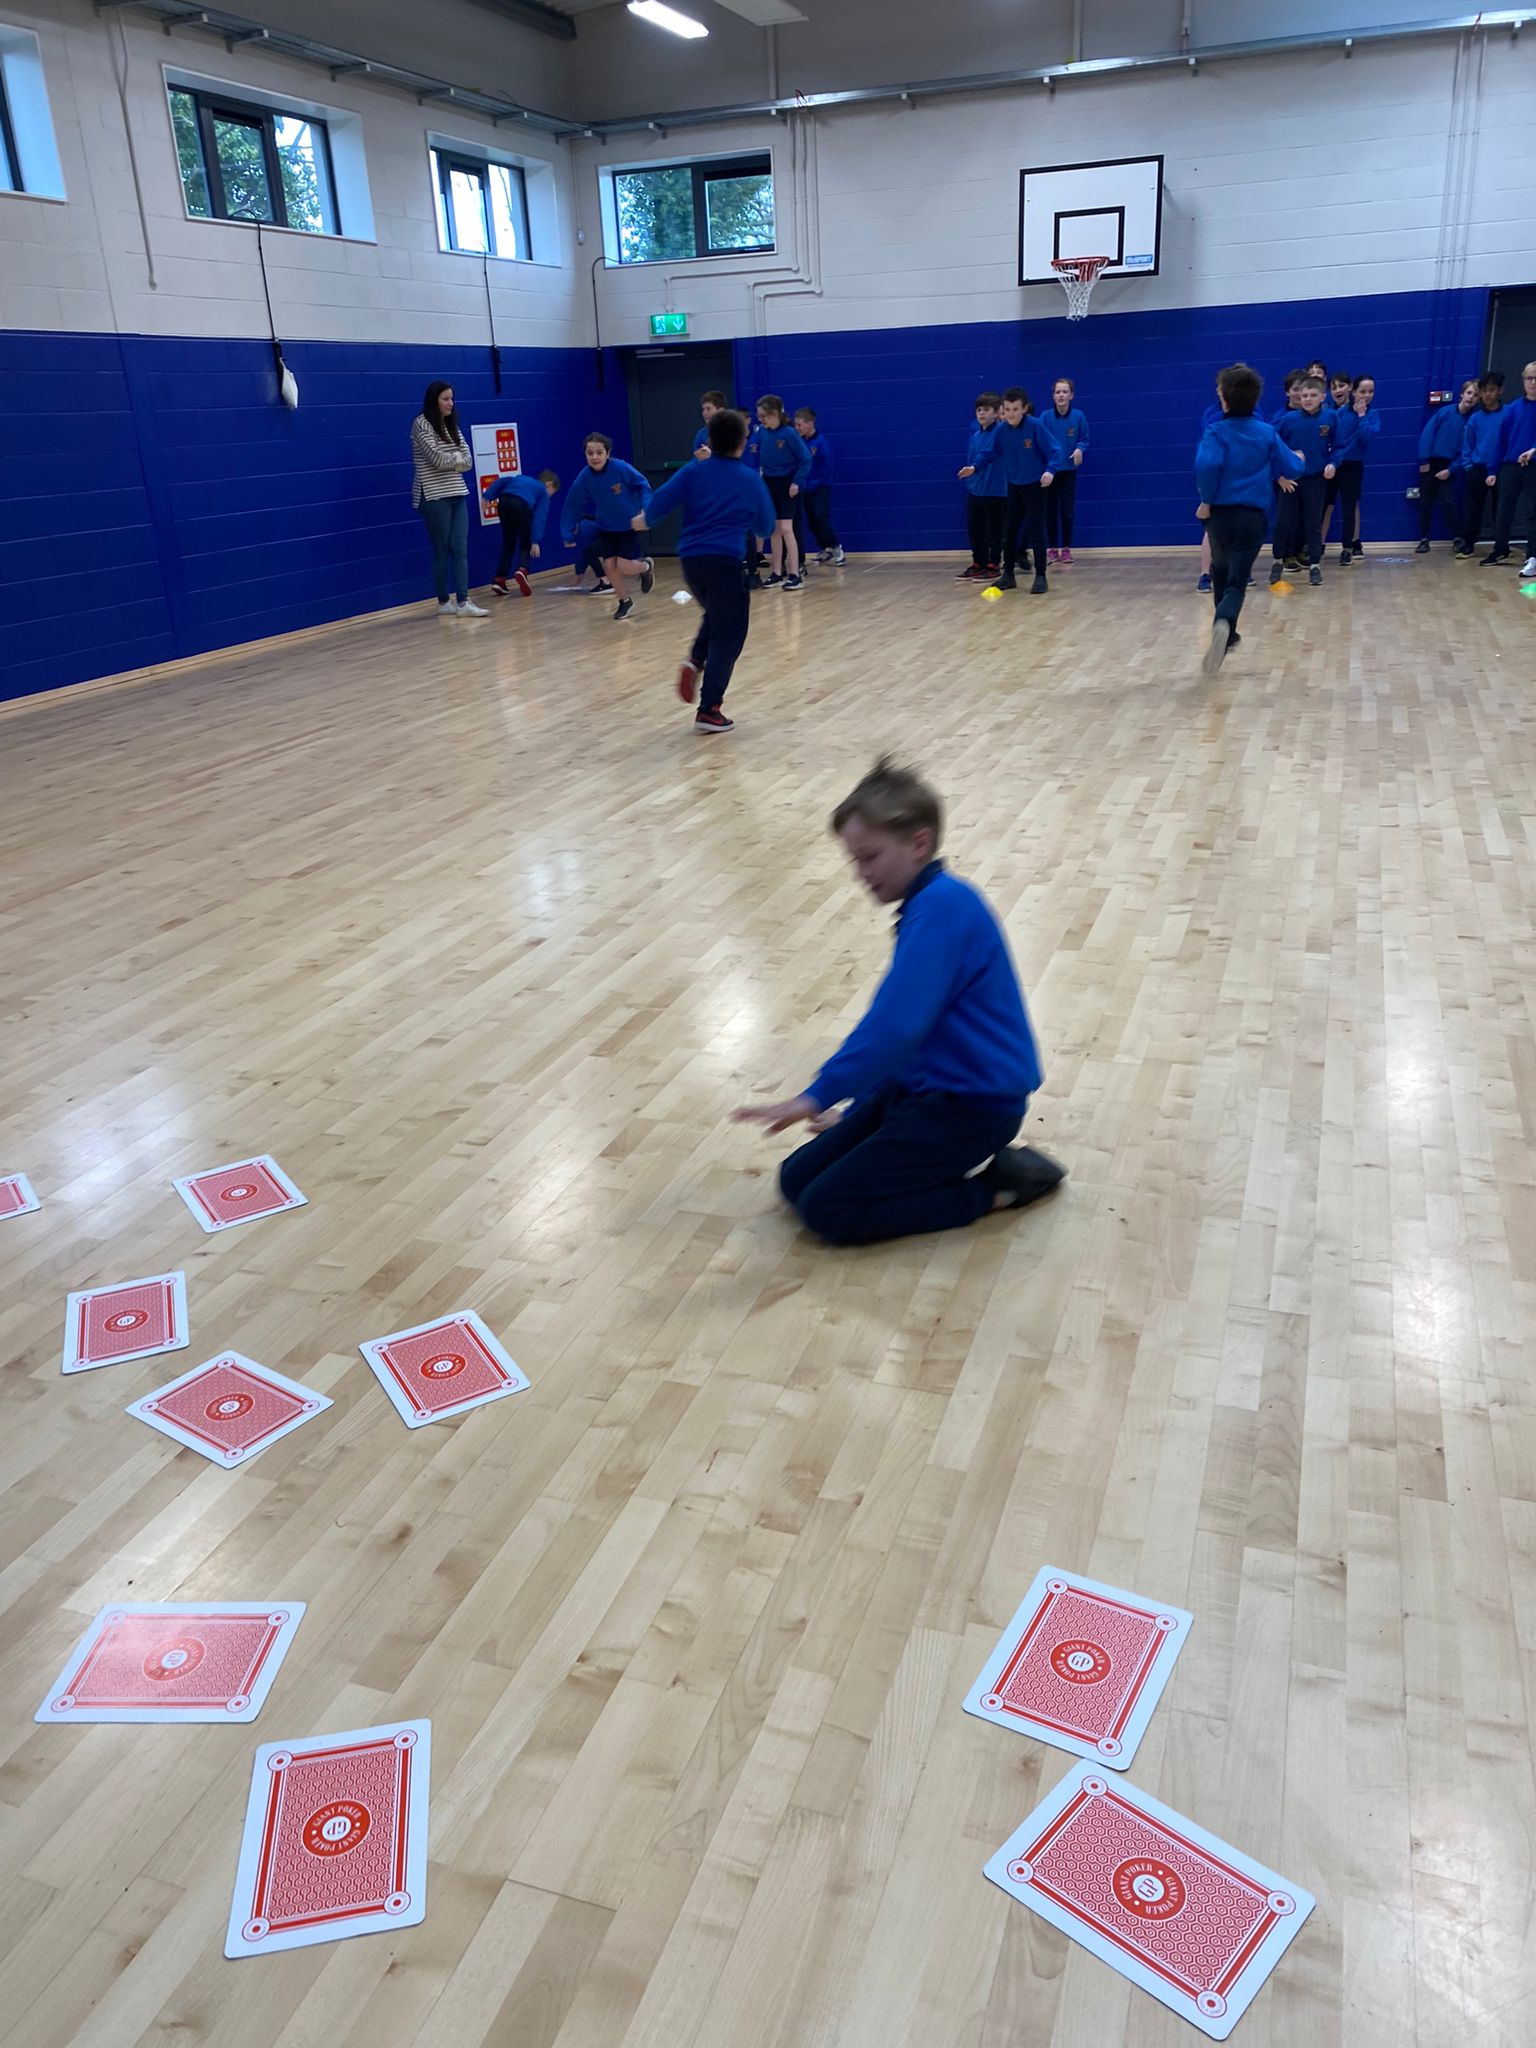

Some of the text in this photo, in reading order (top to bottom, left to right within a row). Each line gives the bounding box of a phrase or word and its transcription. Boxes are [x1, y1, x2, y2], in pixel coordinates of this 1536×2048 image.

[436, 1361, 450, 1371] GP
[1062, 1643, 1106, 1664] GIANT POKER
[1071, 1654, 1090, 1667] GP
[312, 1804, 362, 1827] GIANT POKER
[326, 1820, 347, 1836] GP
[311, 1829, 361, 1852] GIANT POKER
[1119, 1862, 1153, 1901] GIANT POKER
[1137, 1877, 1158, 1899] GP
[1145, 1876, 1179, 1915] GIANT POKER
